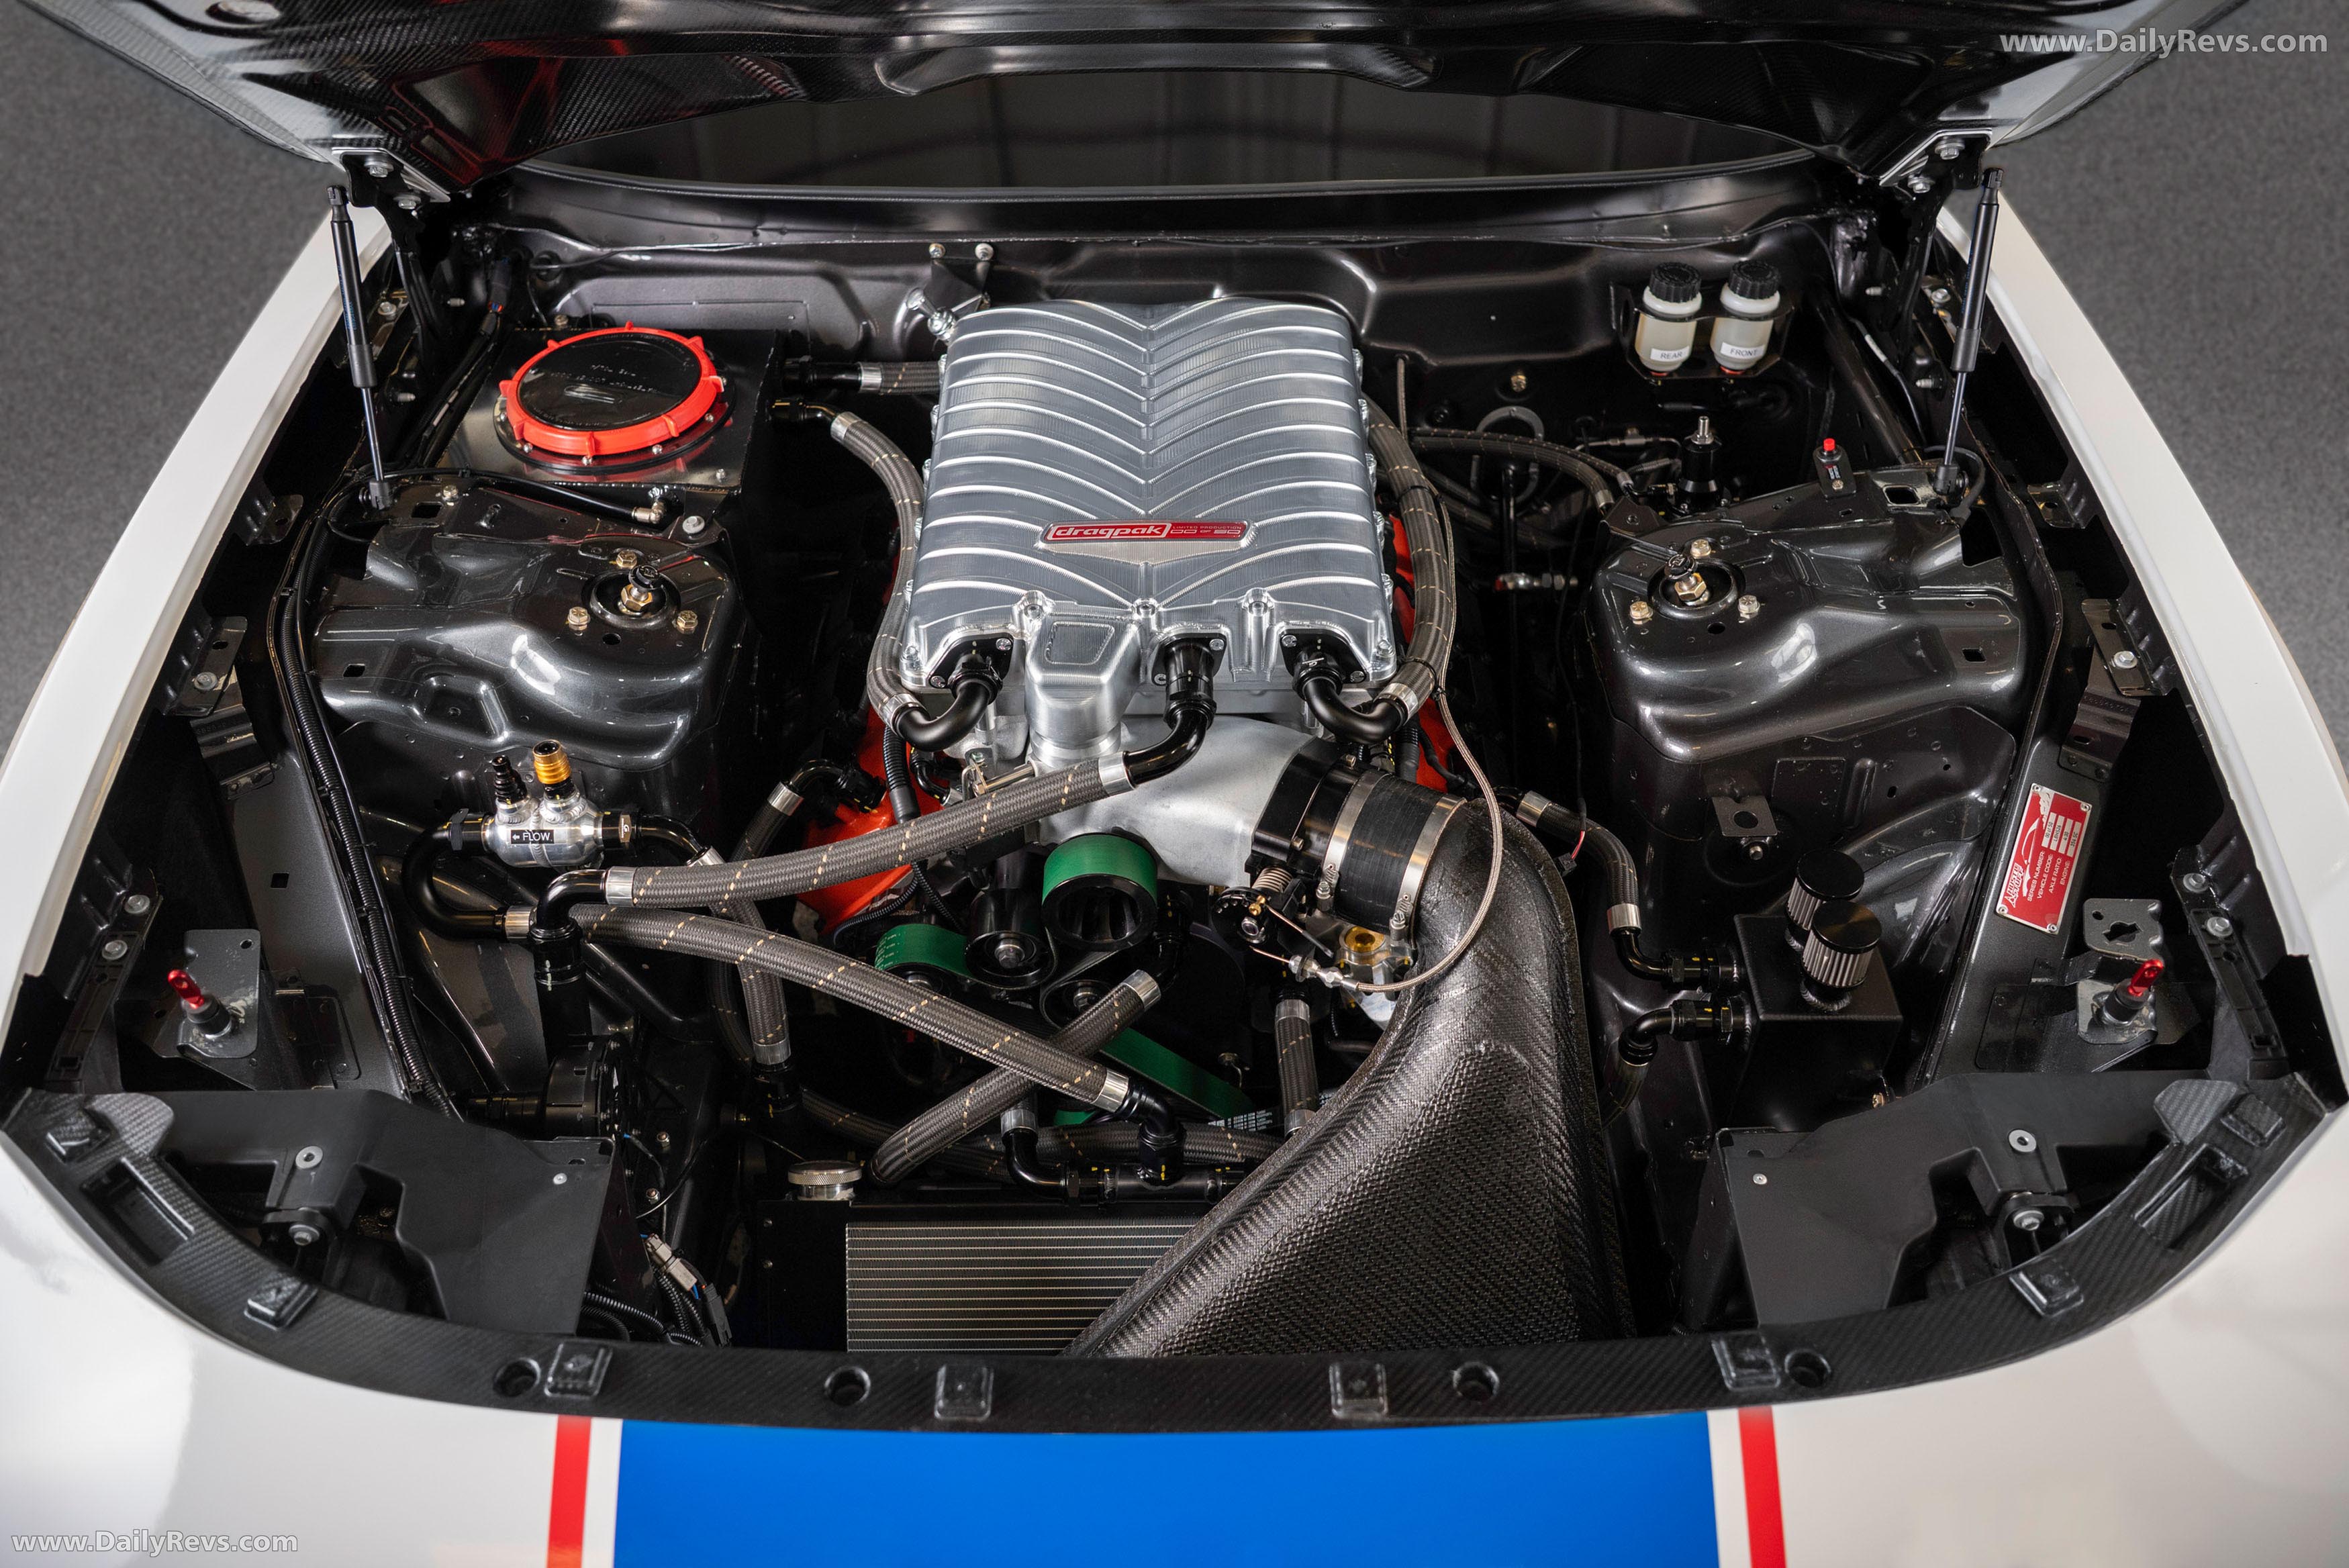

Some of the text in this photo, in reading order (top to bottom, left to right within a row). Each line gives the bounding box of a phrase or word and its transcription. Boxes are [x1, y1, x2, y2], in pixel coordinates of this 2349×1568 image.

[1660, 351, 1683, 359] REAR
[1730, 348, 1758, 356] FRONT
[1055, 526, 1163, 538] dragpak
[2027, 879, 2038, 901] SERIES
[2033, 850, 2045, 879] NUMBER:
[2037, 873, 2048, 898] VEHICLE
[2044, 854, 2054, 873] CODE:
[2048, 877, 2056, 893] AXLE
[2053, 857, 2062, 876] RATIO:
[2060, 861, 2070, 885] ENGINE:
